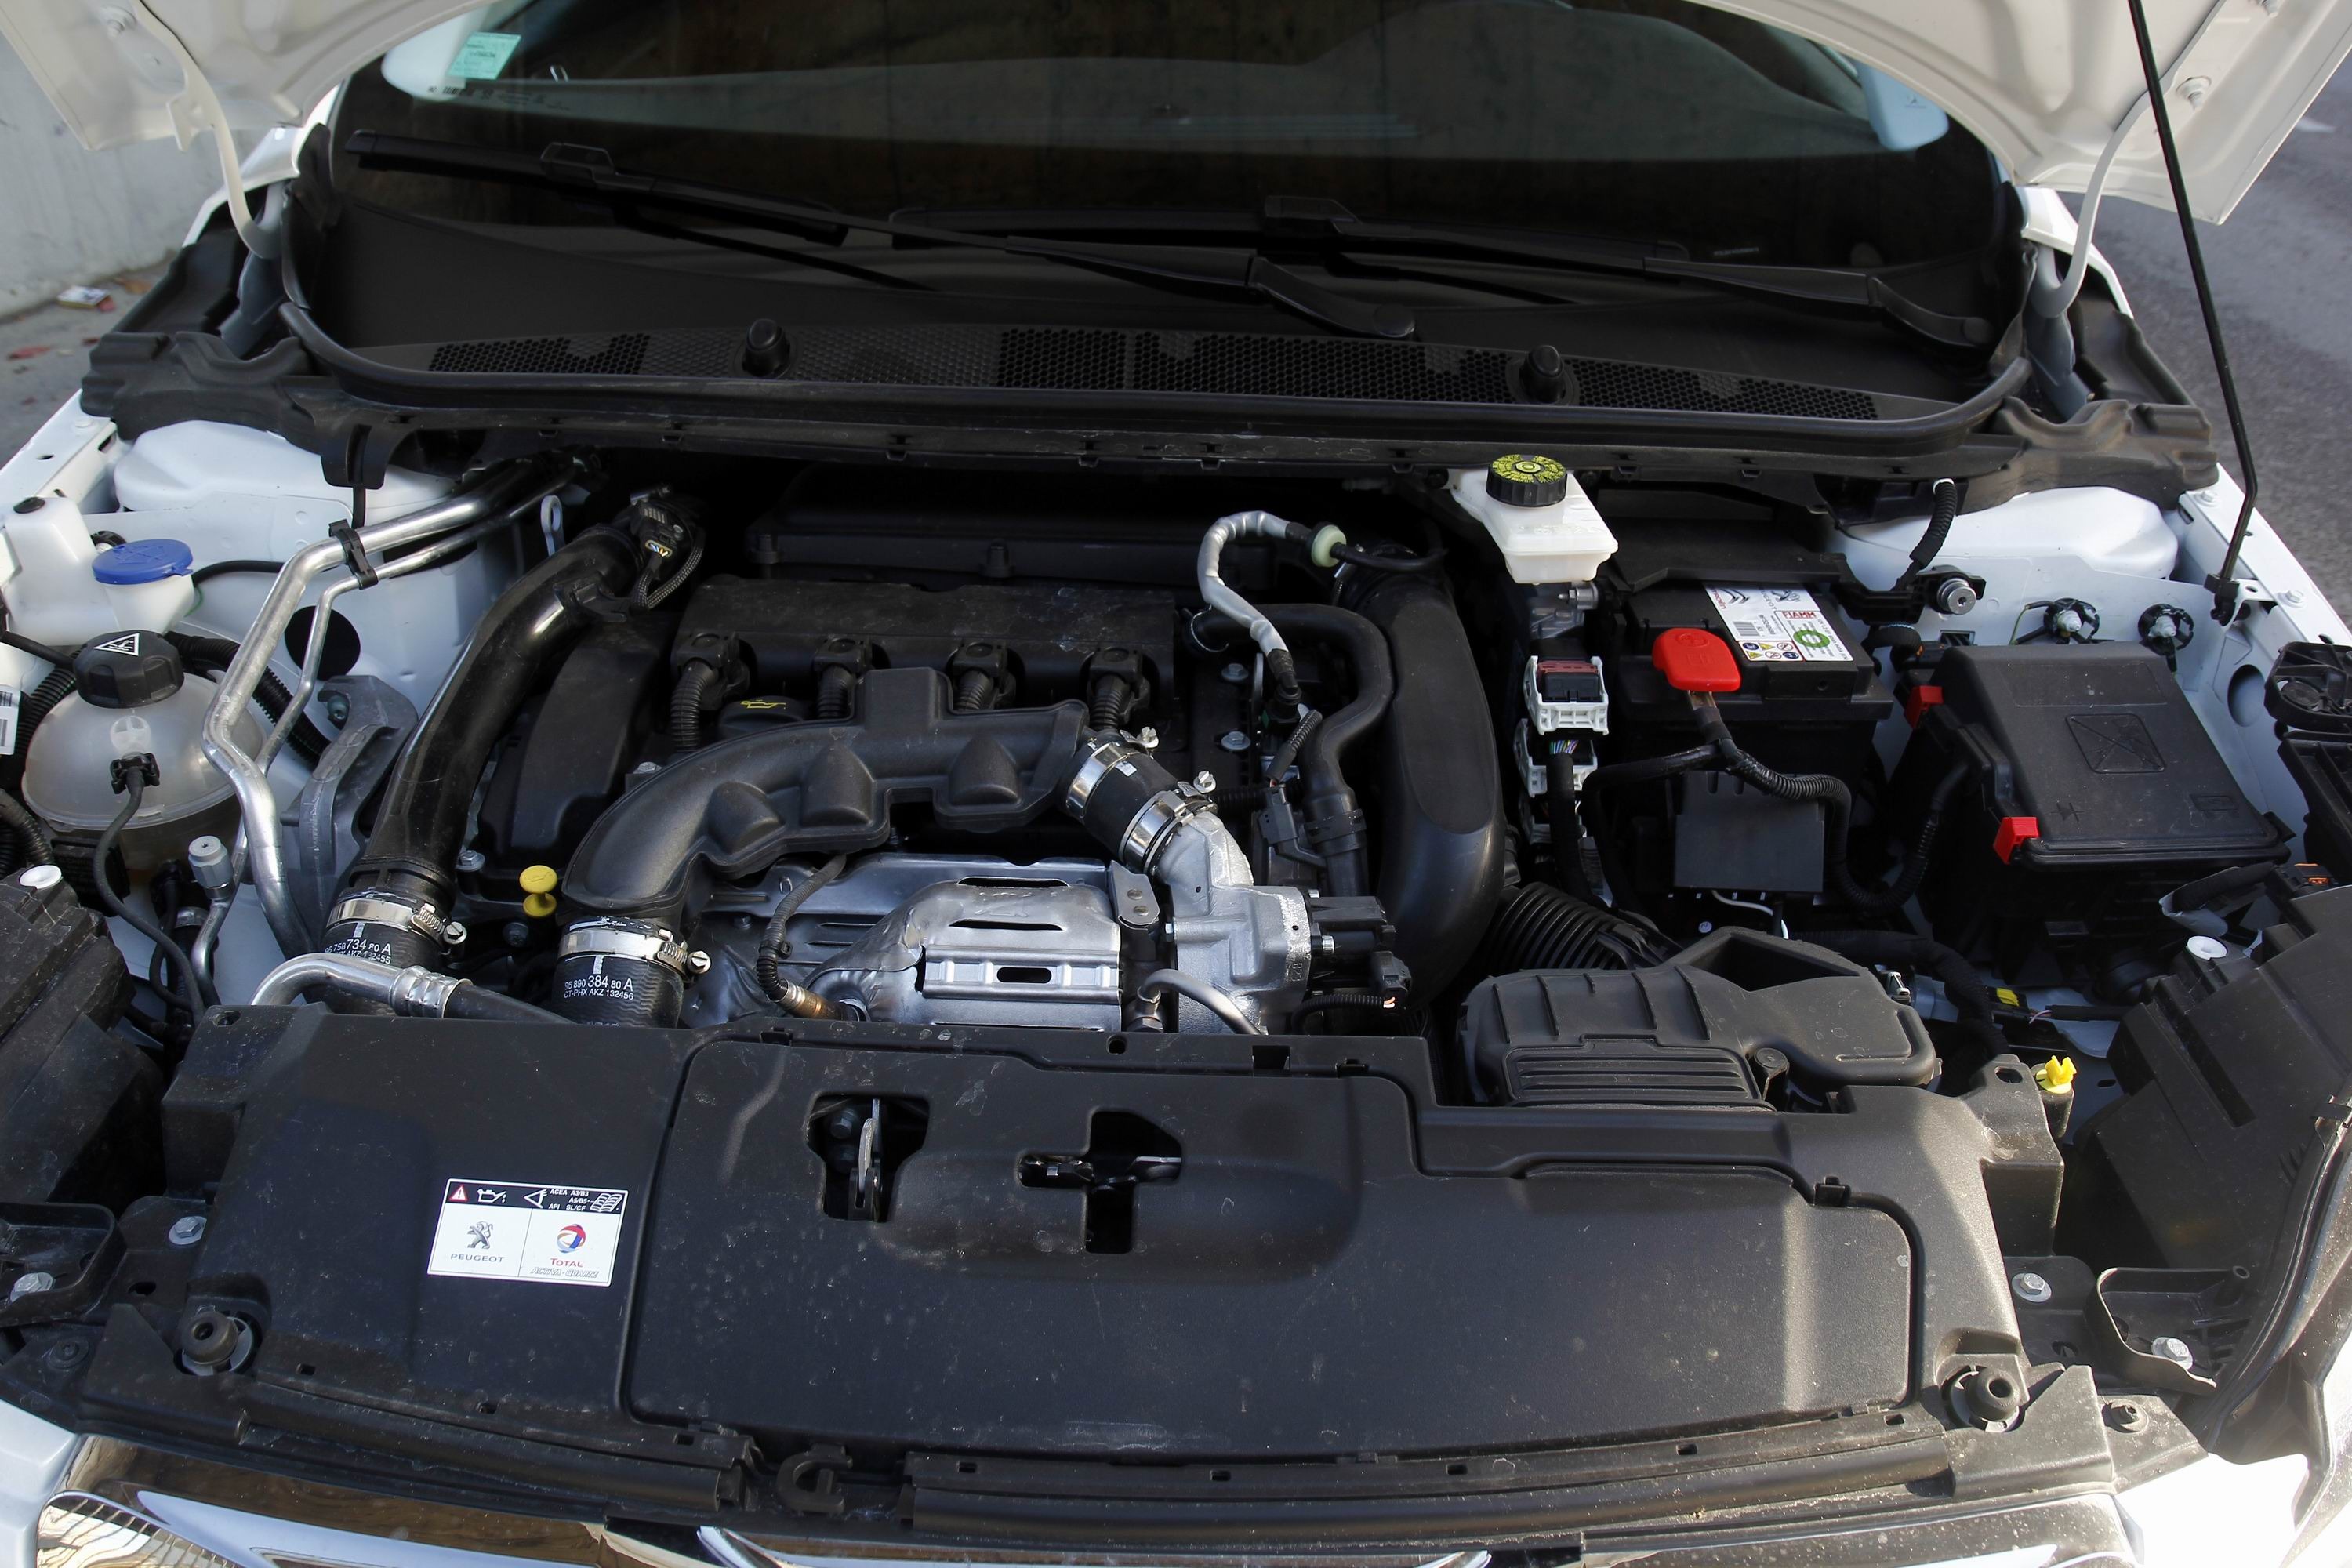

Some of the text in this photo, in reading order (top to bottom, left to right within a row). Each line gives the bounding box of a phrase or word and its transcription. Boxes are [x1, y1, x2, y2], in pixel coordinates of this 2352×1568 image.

[333, 942, 346, 952] 758
[347, 938, 367, 950] 734
[381, 943, 391, 956] A
[573, 978, 586, 989] 890
[587, 975, 609, 988] 384
[610, 979, 622, 989] 80
[623, 978, 633, 992] A
[564, 988, 634, 1000] CT-PHX AKZ 132456
[451, 1254, 505, 1262] PEUGEOT
[550, 1258, 584, 1268] TOTAL
